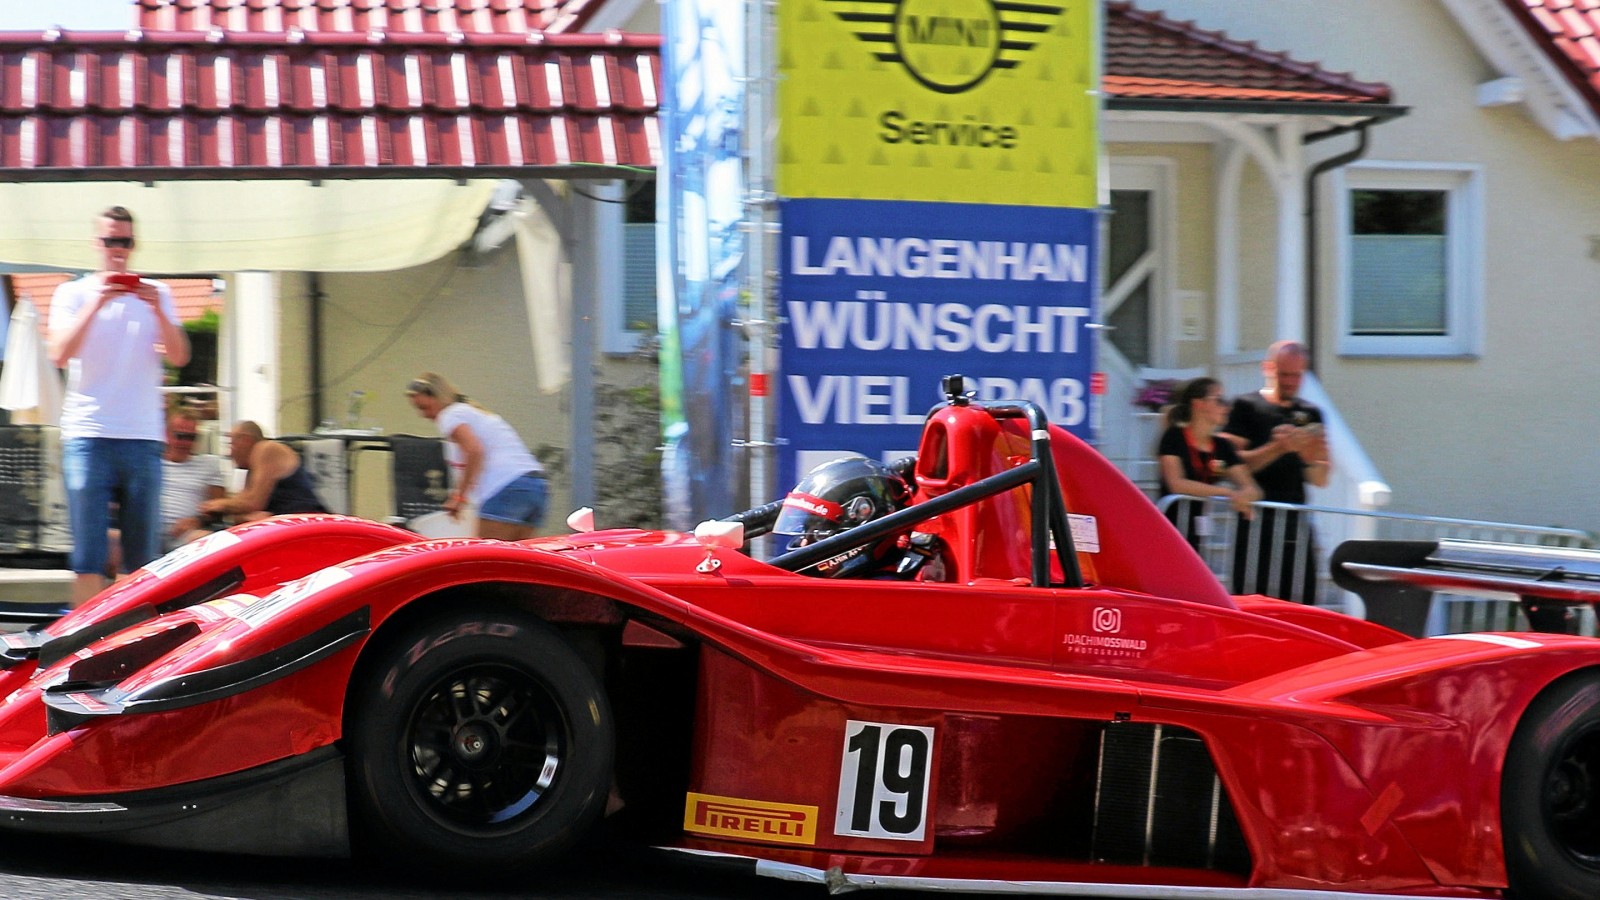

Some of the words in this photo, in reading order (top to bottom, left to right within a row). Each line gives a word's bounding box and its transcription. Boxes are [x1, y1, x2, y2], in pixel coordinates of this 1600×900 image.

[906, 15, 990, 48] MINI
[878, 110, 1019, 150] Service
[790, 236, 1087, 283] LANGENHAN
[787, 291, 1090, 354] WÜNSCHT
[788, 375, 928, 425] VIEL
[848, 724, 929, 834] 19
[694, 800, 807, 837] PIRELLI
